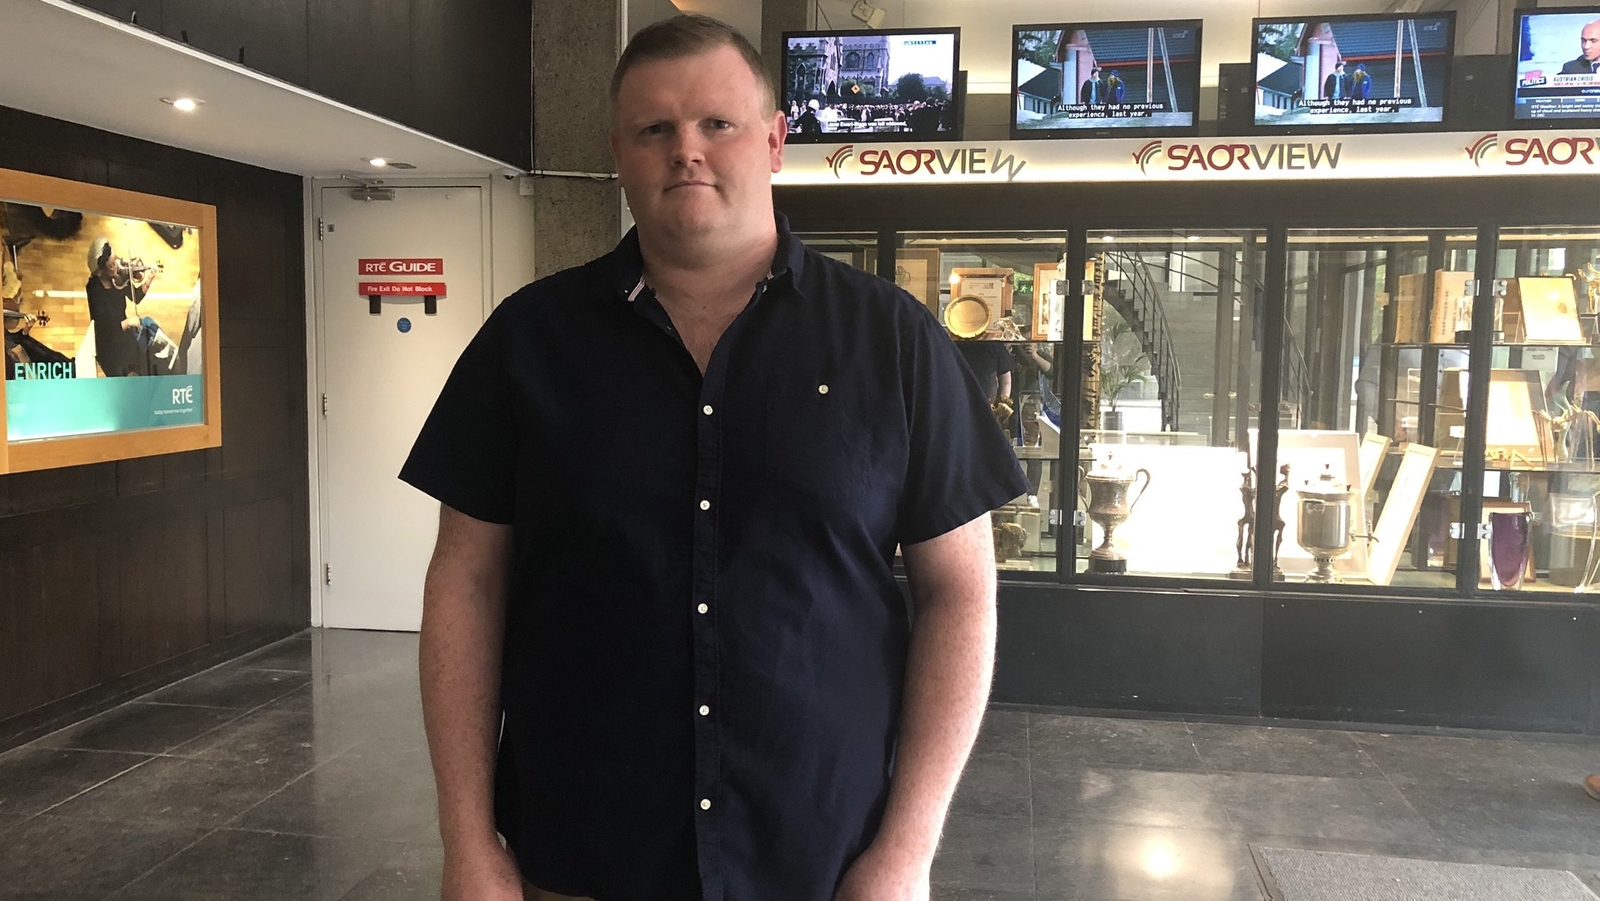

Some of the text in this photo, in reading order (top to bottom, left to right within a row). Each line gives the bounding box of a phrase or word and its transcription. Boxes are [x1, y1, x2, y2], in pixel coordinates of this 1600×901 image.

[1333, 99, 1350, 107] they
[1379, 98, 1412, 106] previous
[1167, 142, 1342, 171] SAORVIEW
[1504, 136, 1600, 166] SAOR
[859, 147, 1026, 182] SAORVIEW
[365, 260, 436, 273] RTÉ GUIDE
[14, 361, 73, 381] ENRICH
[172, 384, 193, 405] RTÉ
